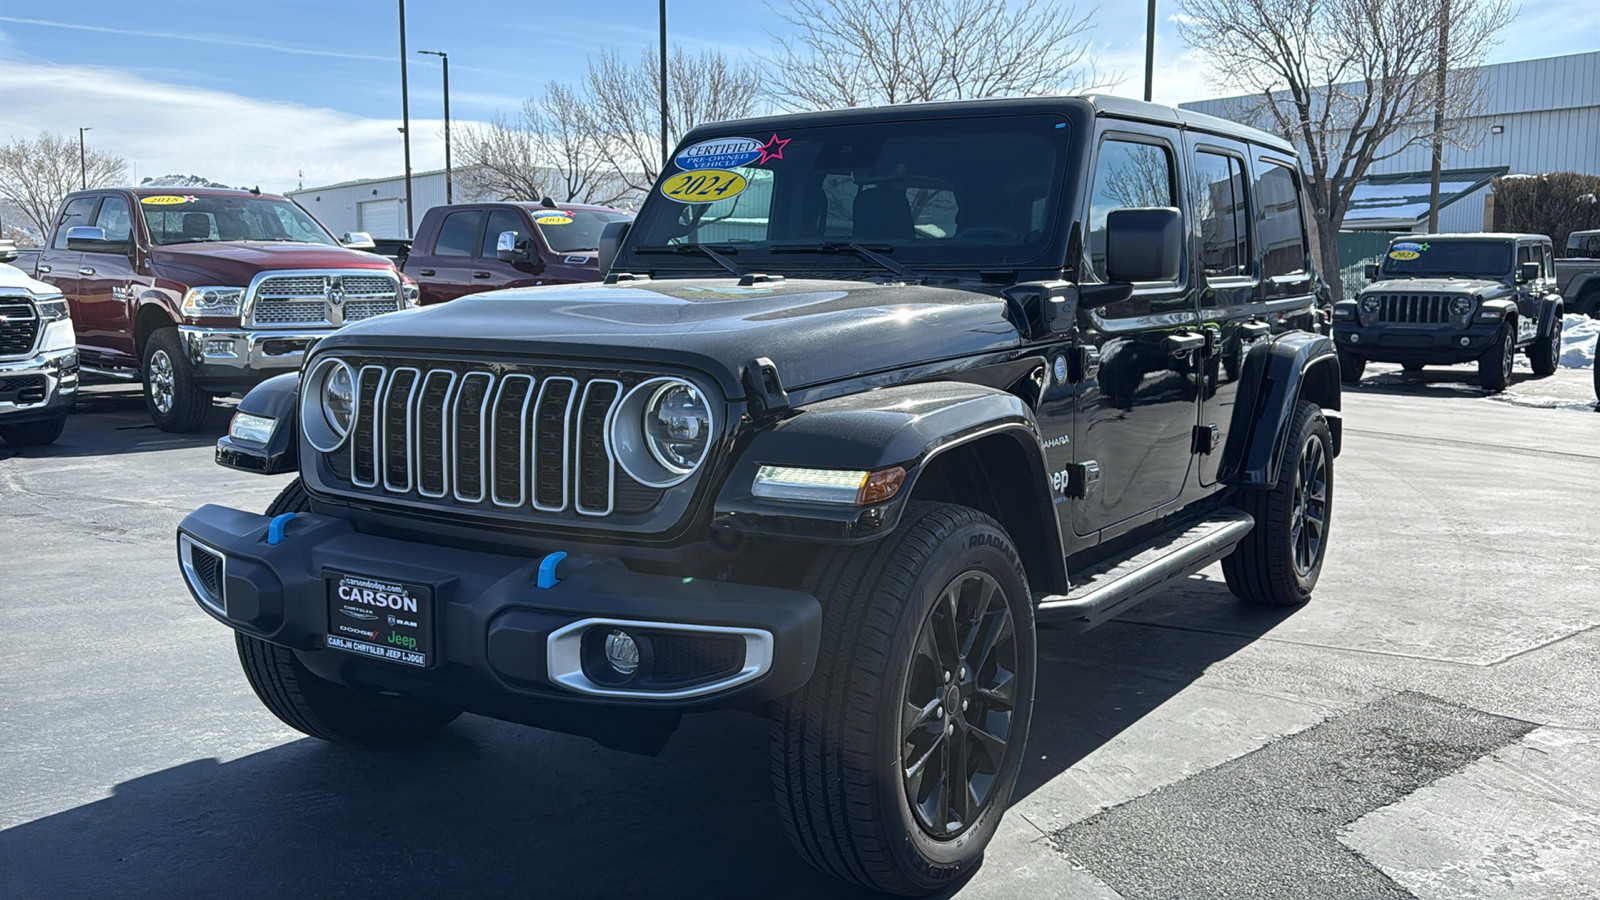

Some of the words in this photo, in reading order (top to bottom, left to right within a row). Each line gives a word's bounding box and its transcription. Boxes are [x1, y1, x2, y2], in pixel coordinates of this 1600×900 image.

[687, 142, 757, 156] CERTIFIED
[687, 153, 749, 164] PRE-OWNED
[694, 160, 738, 169] VEHICLE
[669, 175, 739, 196] 2024
[1042, 435, 1069, 448] AHARA
[1048, 470, 1069, 493] ep
[346, 577, 402, 593] carsondodge.com
[338, 586, 418, 613] CARSON
[343, 604, 374, 615] CHRYSLER
[396, 618, 418, 628] RAM
[340, 625, 374, 637] DODGE
[387, 630, 417, 650] Jeep
[353, 642, 385, 655] CHRYSLER
[386, 649, 401, 659] JEEP
